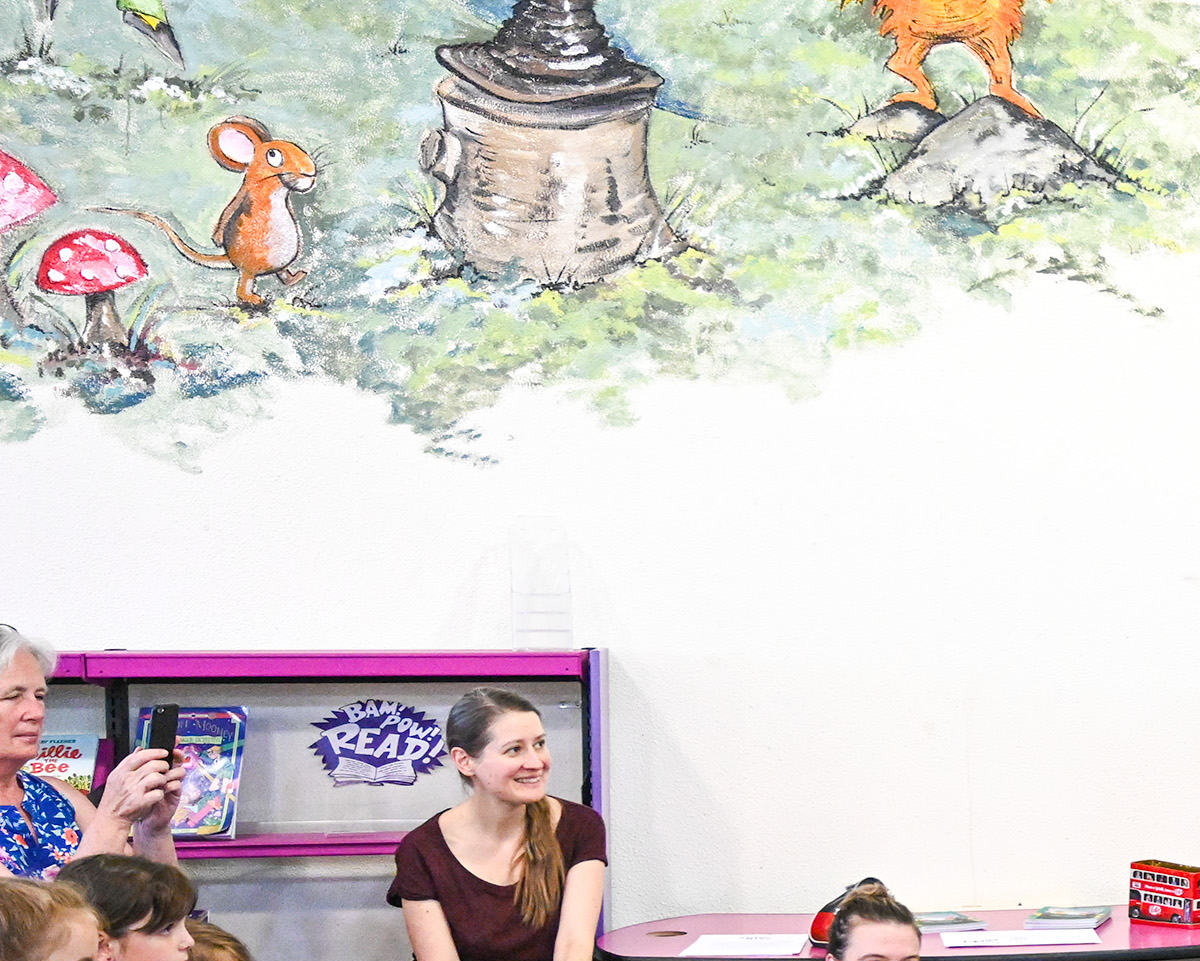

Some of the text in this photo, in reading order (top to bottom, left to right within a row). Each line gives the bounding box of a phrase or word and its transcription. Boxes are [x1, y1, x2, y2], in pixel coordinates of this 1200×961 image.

[340, 699, 408, 723] BAM!
[195, 719, 234, 742] MOONEY
[380, 714, 441, 741] POW!
[36, 744, 83, 760] illie
[320, 723, 445, 764] READ!
[30, 762, 69, 774] Bee
